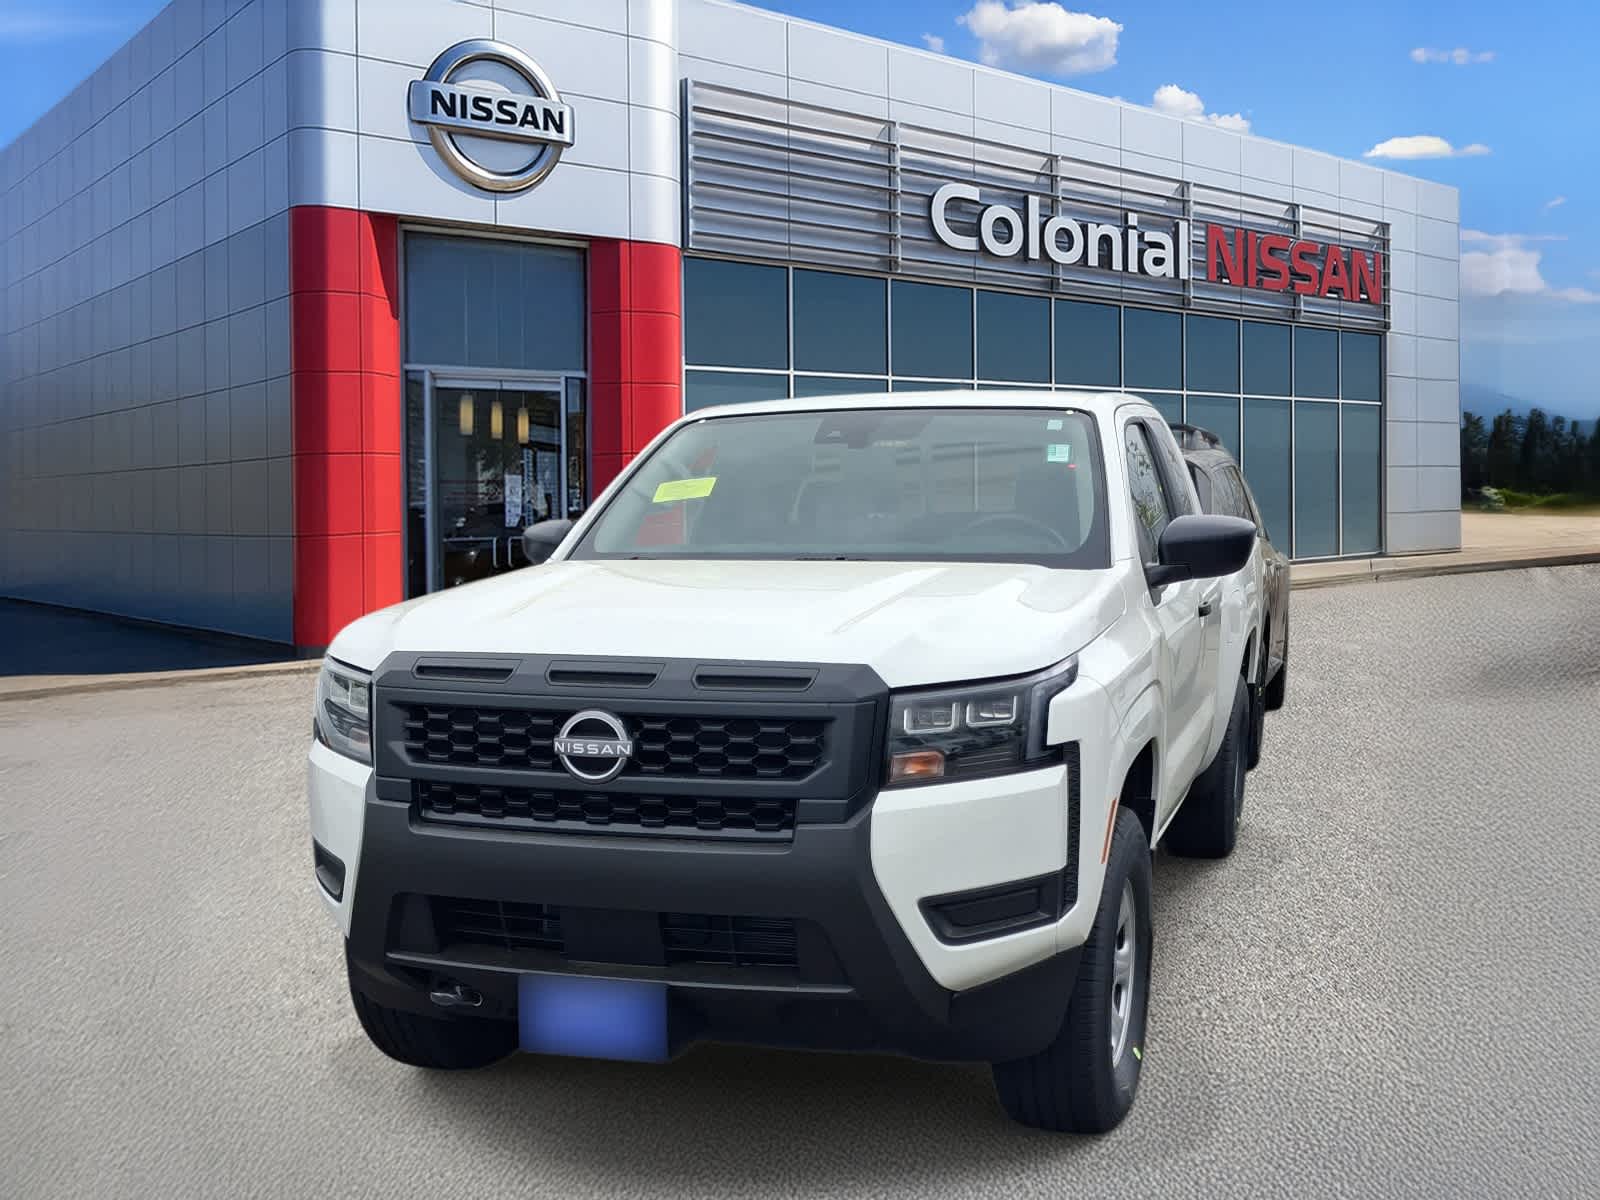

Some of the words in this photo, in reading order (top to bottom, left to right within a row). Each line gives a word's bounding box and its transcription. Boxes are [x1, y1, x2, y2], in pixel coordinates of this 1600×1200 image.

[430, 89, 564, 134] NISSAN
[930, 183, 1188, 280] Colonial
[1207, 224, 1381, 304] NISSAN
[554, 741, 631, 755] NISSAN
